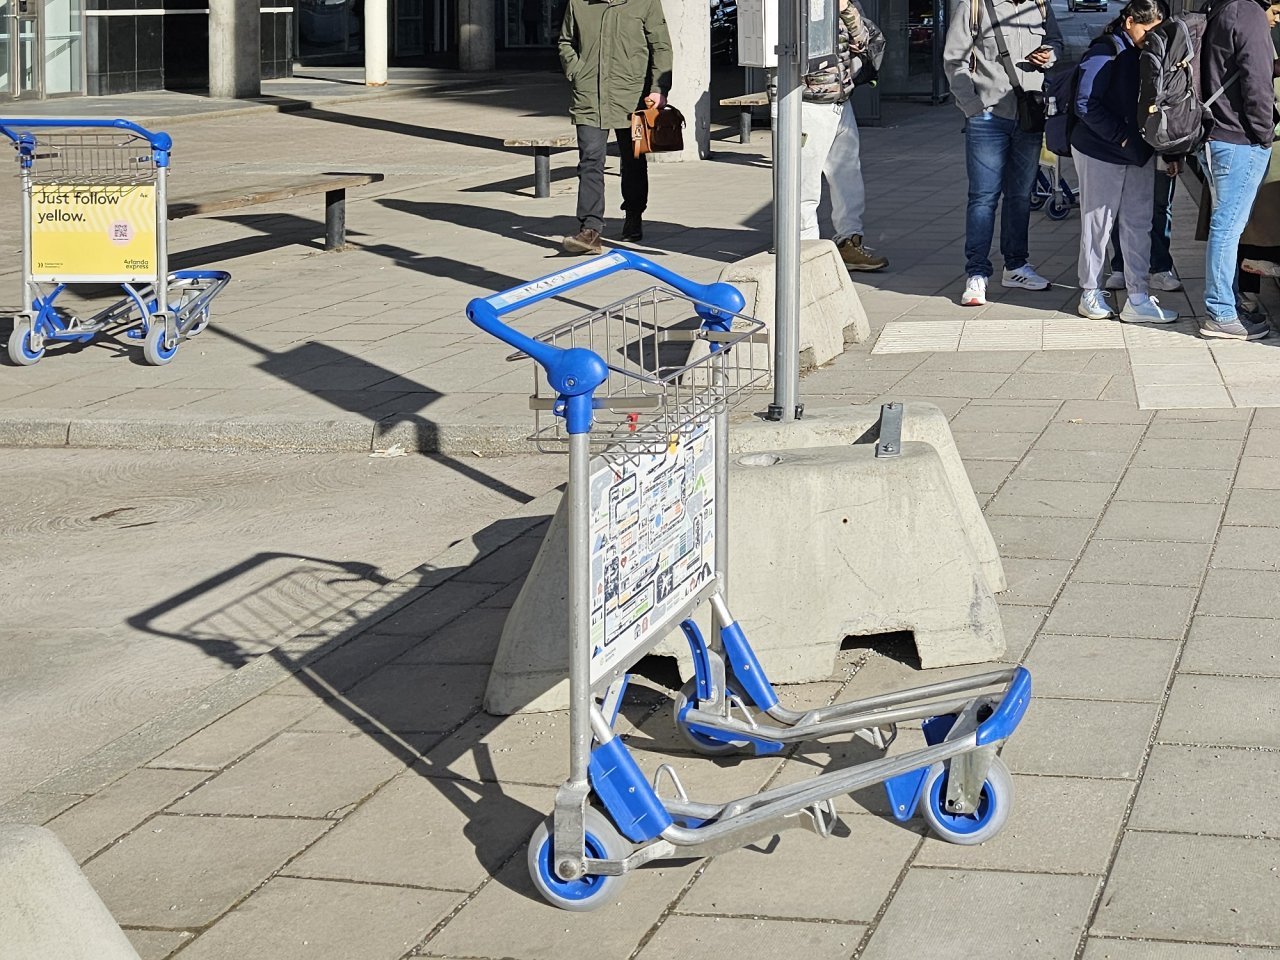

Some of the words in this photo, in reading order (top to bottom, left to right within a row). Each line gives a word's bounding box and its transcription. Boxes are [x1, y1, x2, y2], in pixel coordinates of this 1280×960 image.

[38, 191, 69, 205] Just
[74, 191, 120, 205] follow
[38, 209, 86, 224] yellow.
